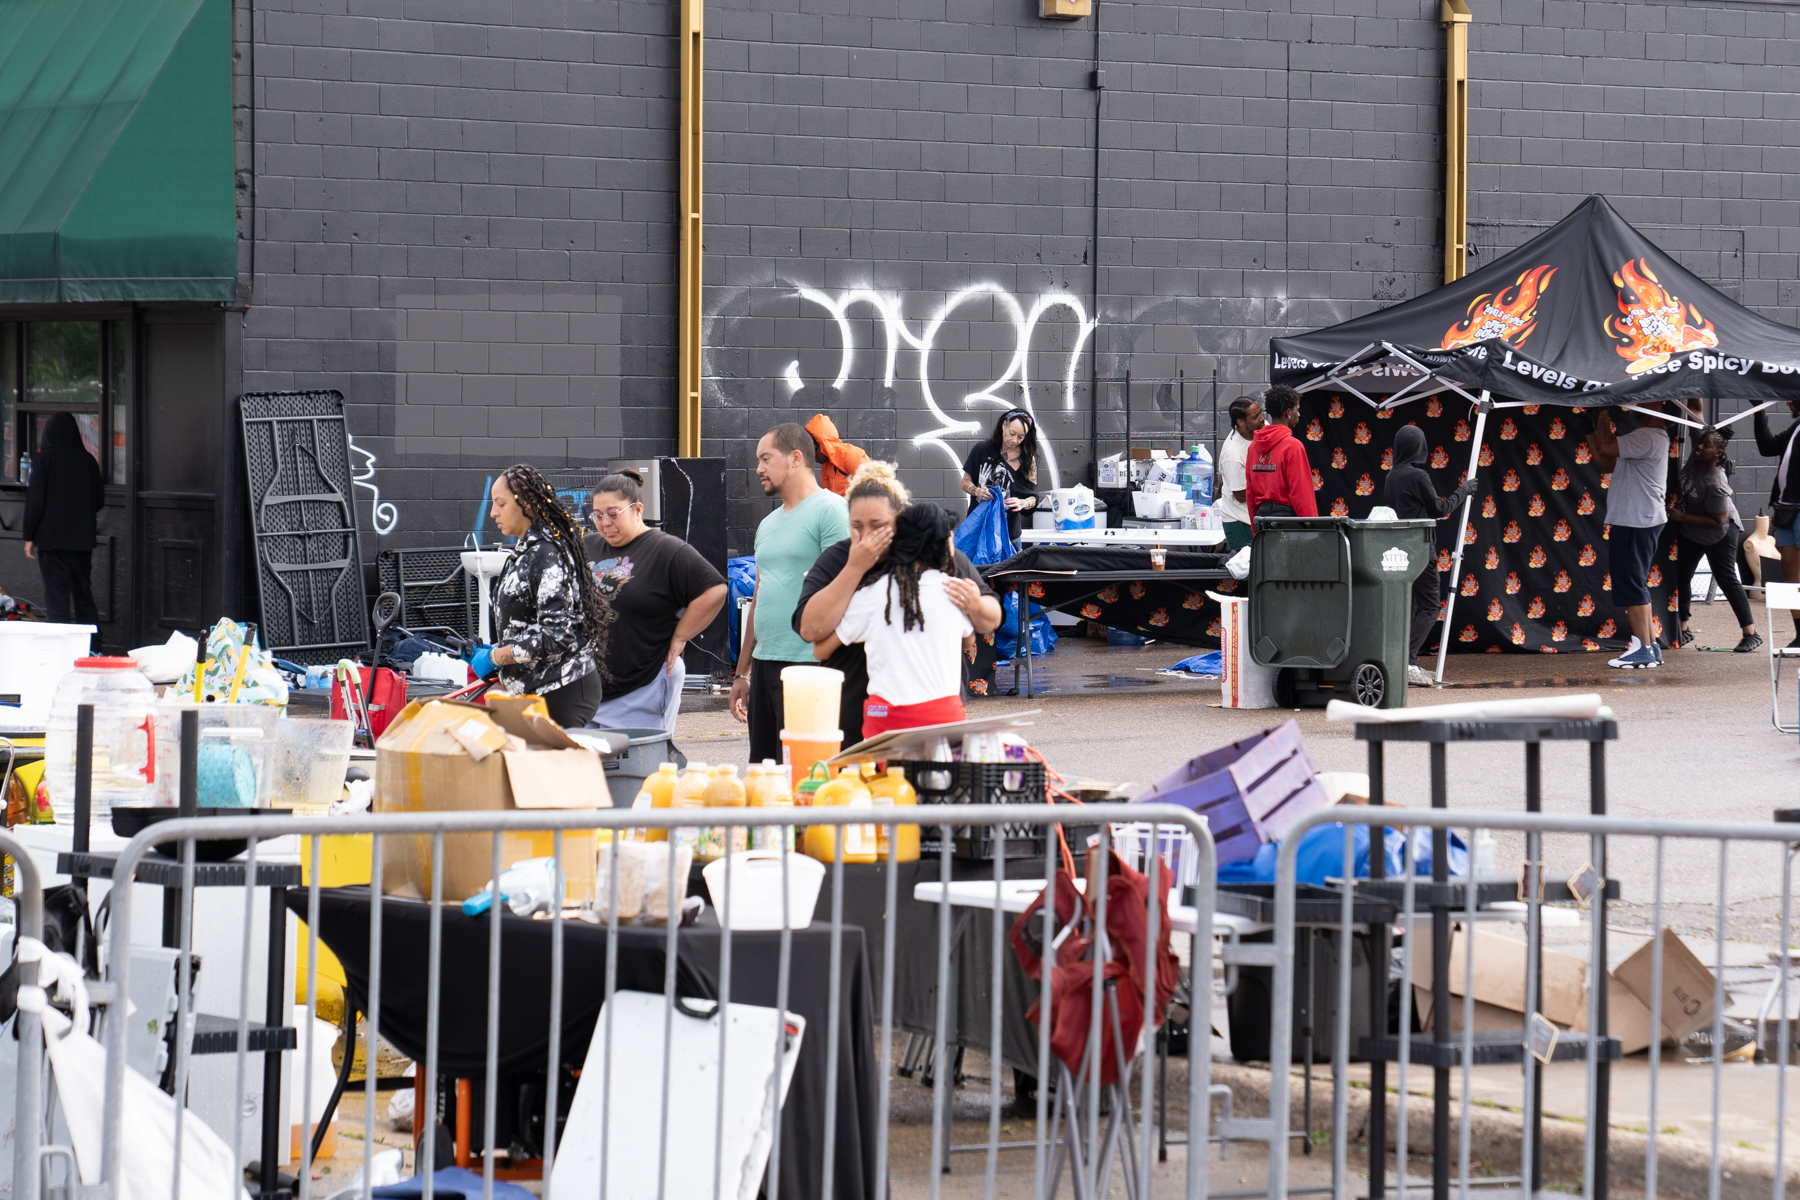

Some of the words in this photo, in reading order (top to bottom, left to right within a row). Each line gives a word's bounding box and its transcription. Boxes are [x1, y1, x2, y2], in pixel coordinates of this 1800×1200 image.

[1482, 319, 1510, 333] SPICY
[1474, 328, 1503, 339] BOW
[1502, 350, 1578, 389] Levels
[1688, 351, 1755, 375] Spicy
[1383, 553, 1407, 562] NITTI
